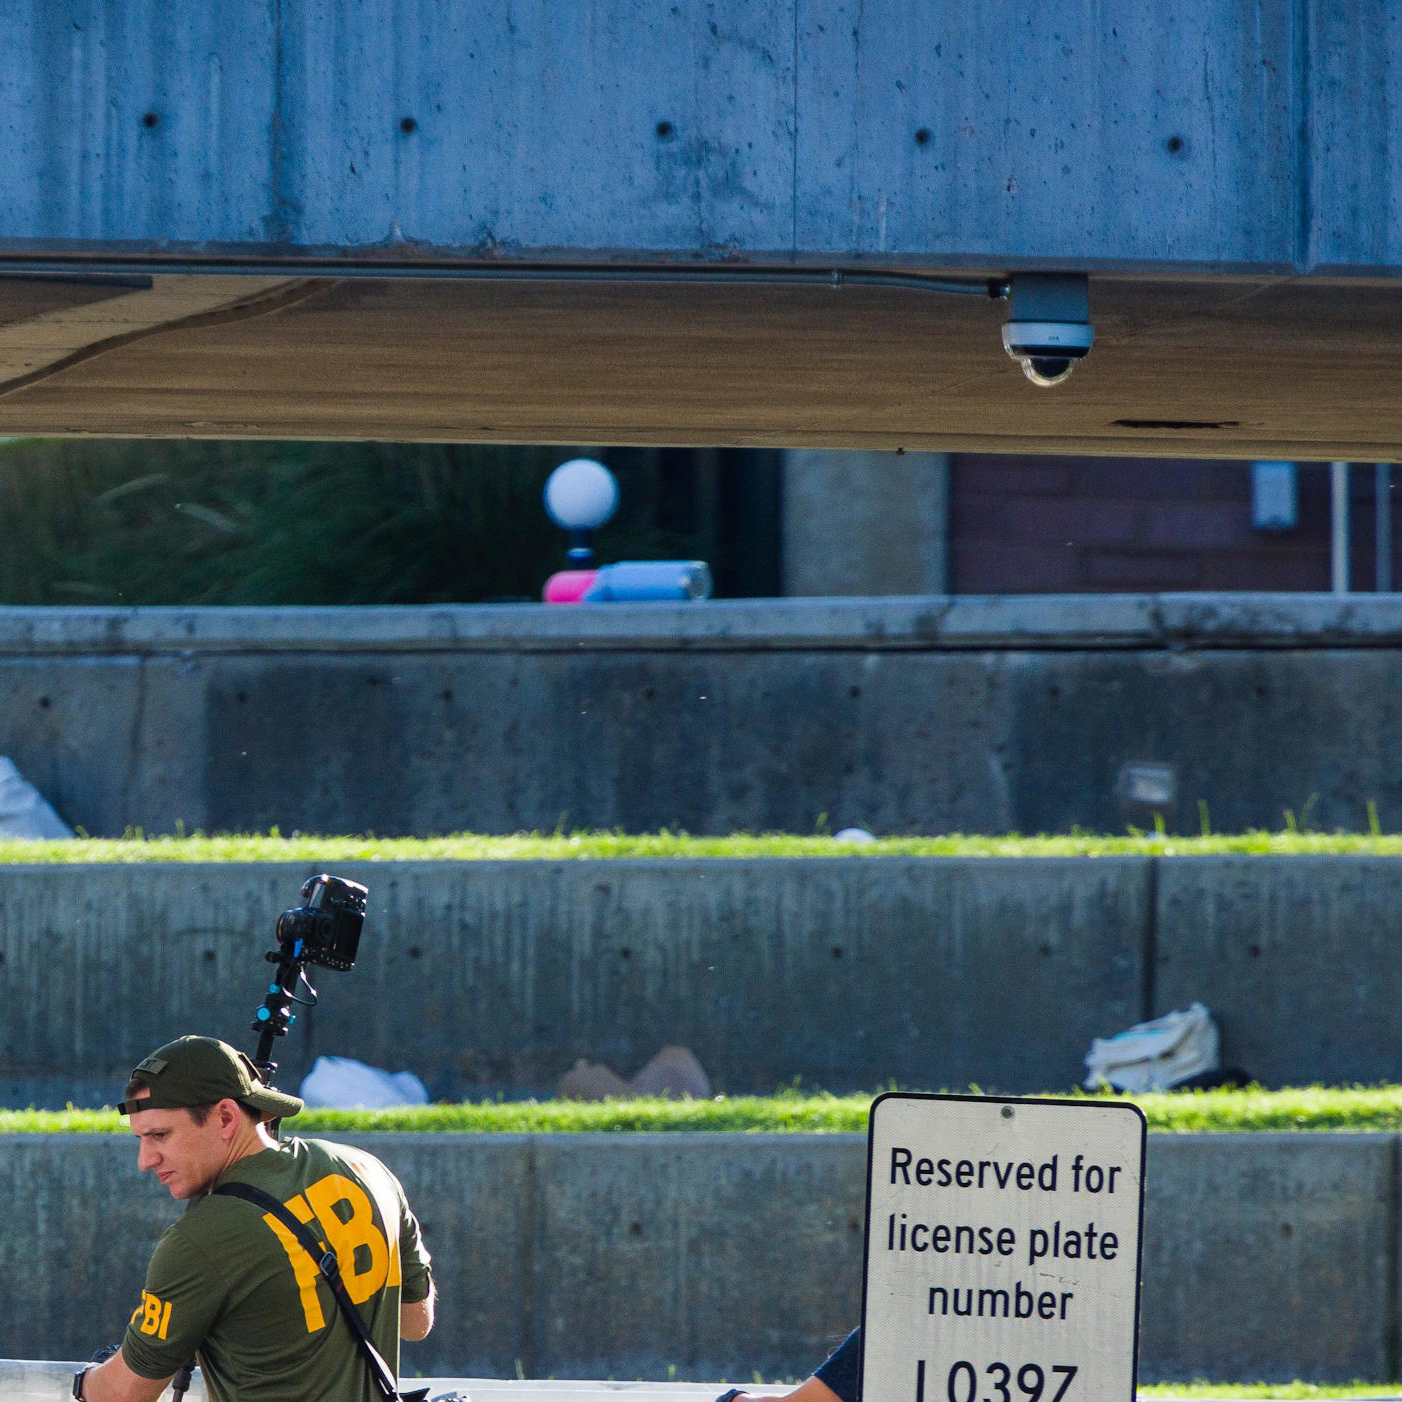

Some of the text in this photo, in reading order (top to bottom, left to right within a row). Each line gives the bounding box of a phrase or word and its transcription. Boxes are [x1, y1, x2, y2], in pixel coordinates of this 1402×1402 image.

[890, 1147, 1122, 1194] Reserved for
[888, 1213, 1119, 1266] license plate
[129, 1289, 172, 1341] FBI
[928, 1281, 1073, 1320] number
